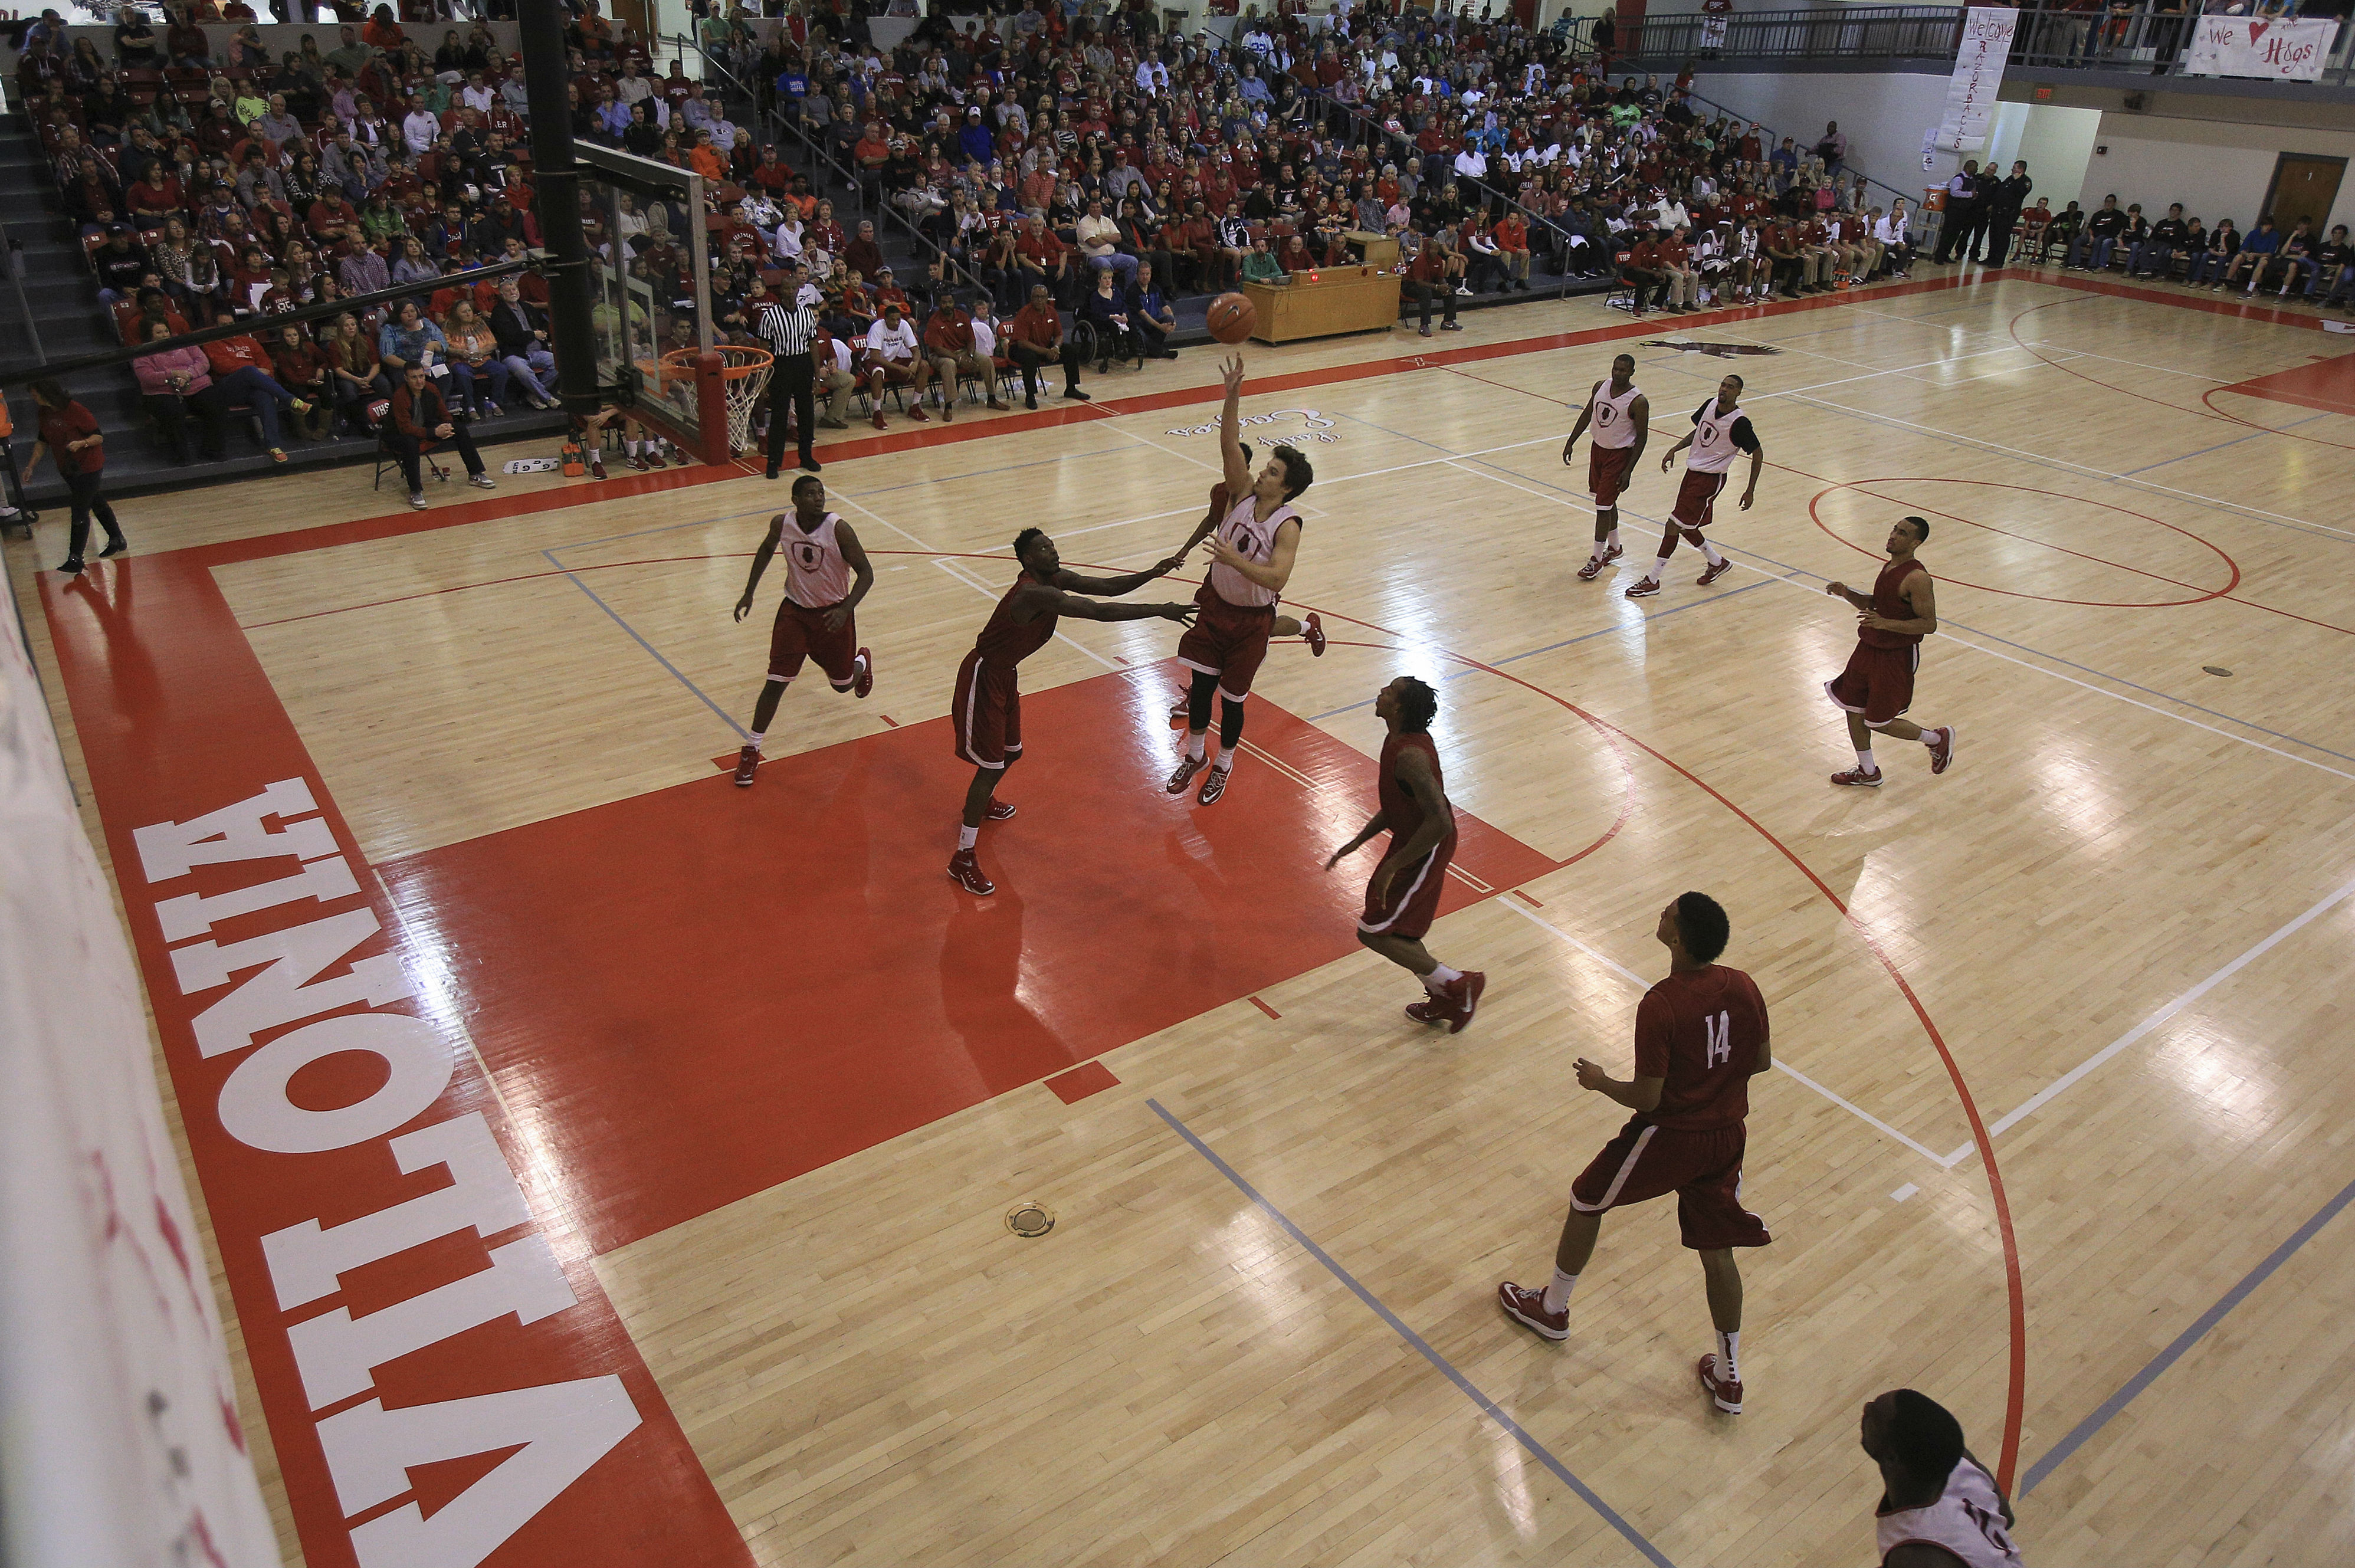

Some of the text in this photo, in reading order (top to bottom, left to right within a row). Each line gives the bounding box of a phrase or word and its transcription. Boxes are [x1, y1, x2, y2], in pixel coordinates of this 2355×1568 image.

[1969, 12, 2014, 49] Welcome
[2210, 24, 2233, 46] We
[1953, 41, 1987, 149] RAZORBACKS
[2037, 89, 2051, 99] EXIT
[852, 339, 867, 349] VH
[373, 402, 390, 417] VHS
[1165, 409, 1336, 438] Eaes
[1705, 1009, 1731, 1070] 14
[132, 776, 644, 1568] VILONIA
